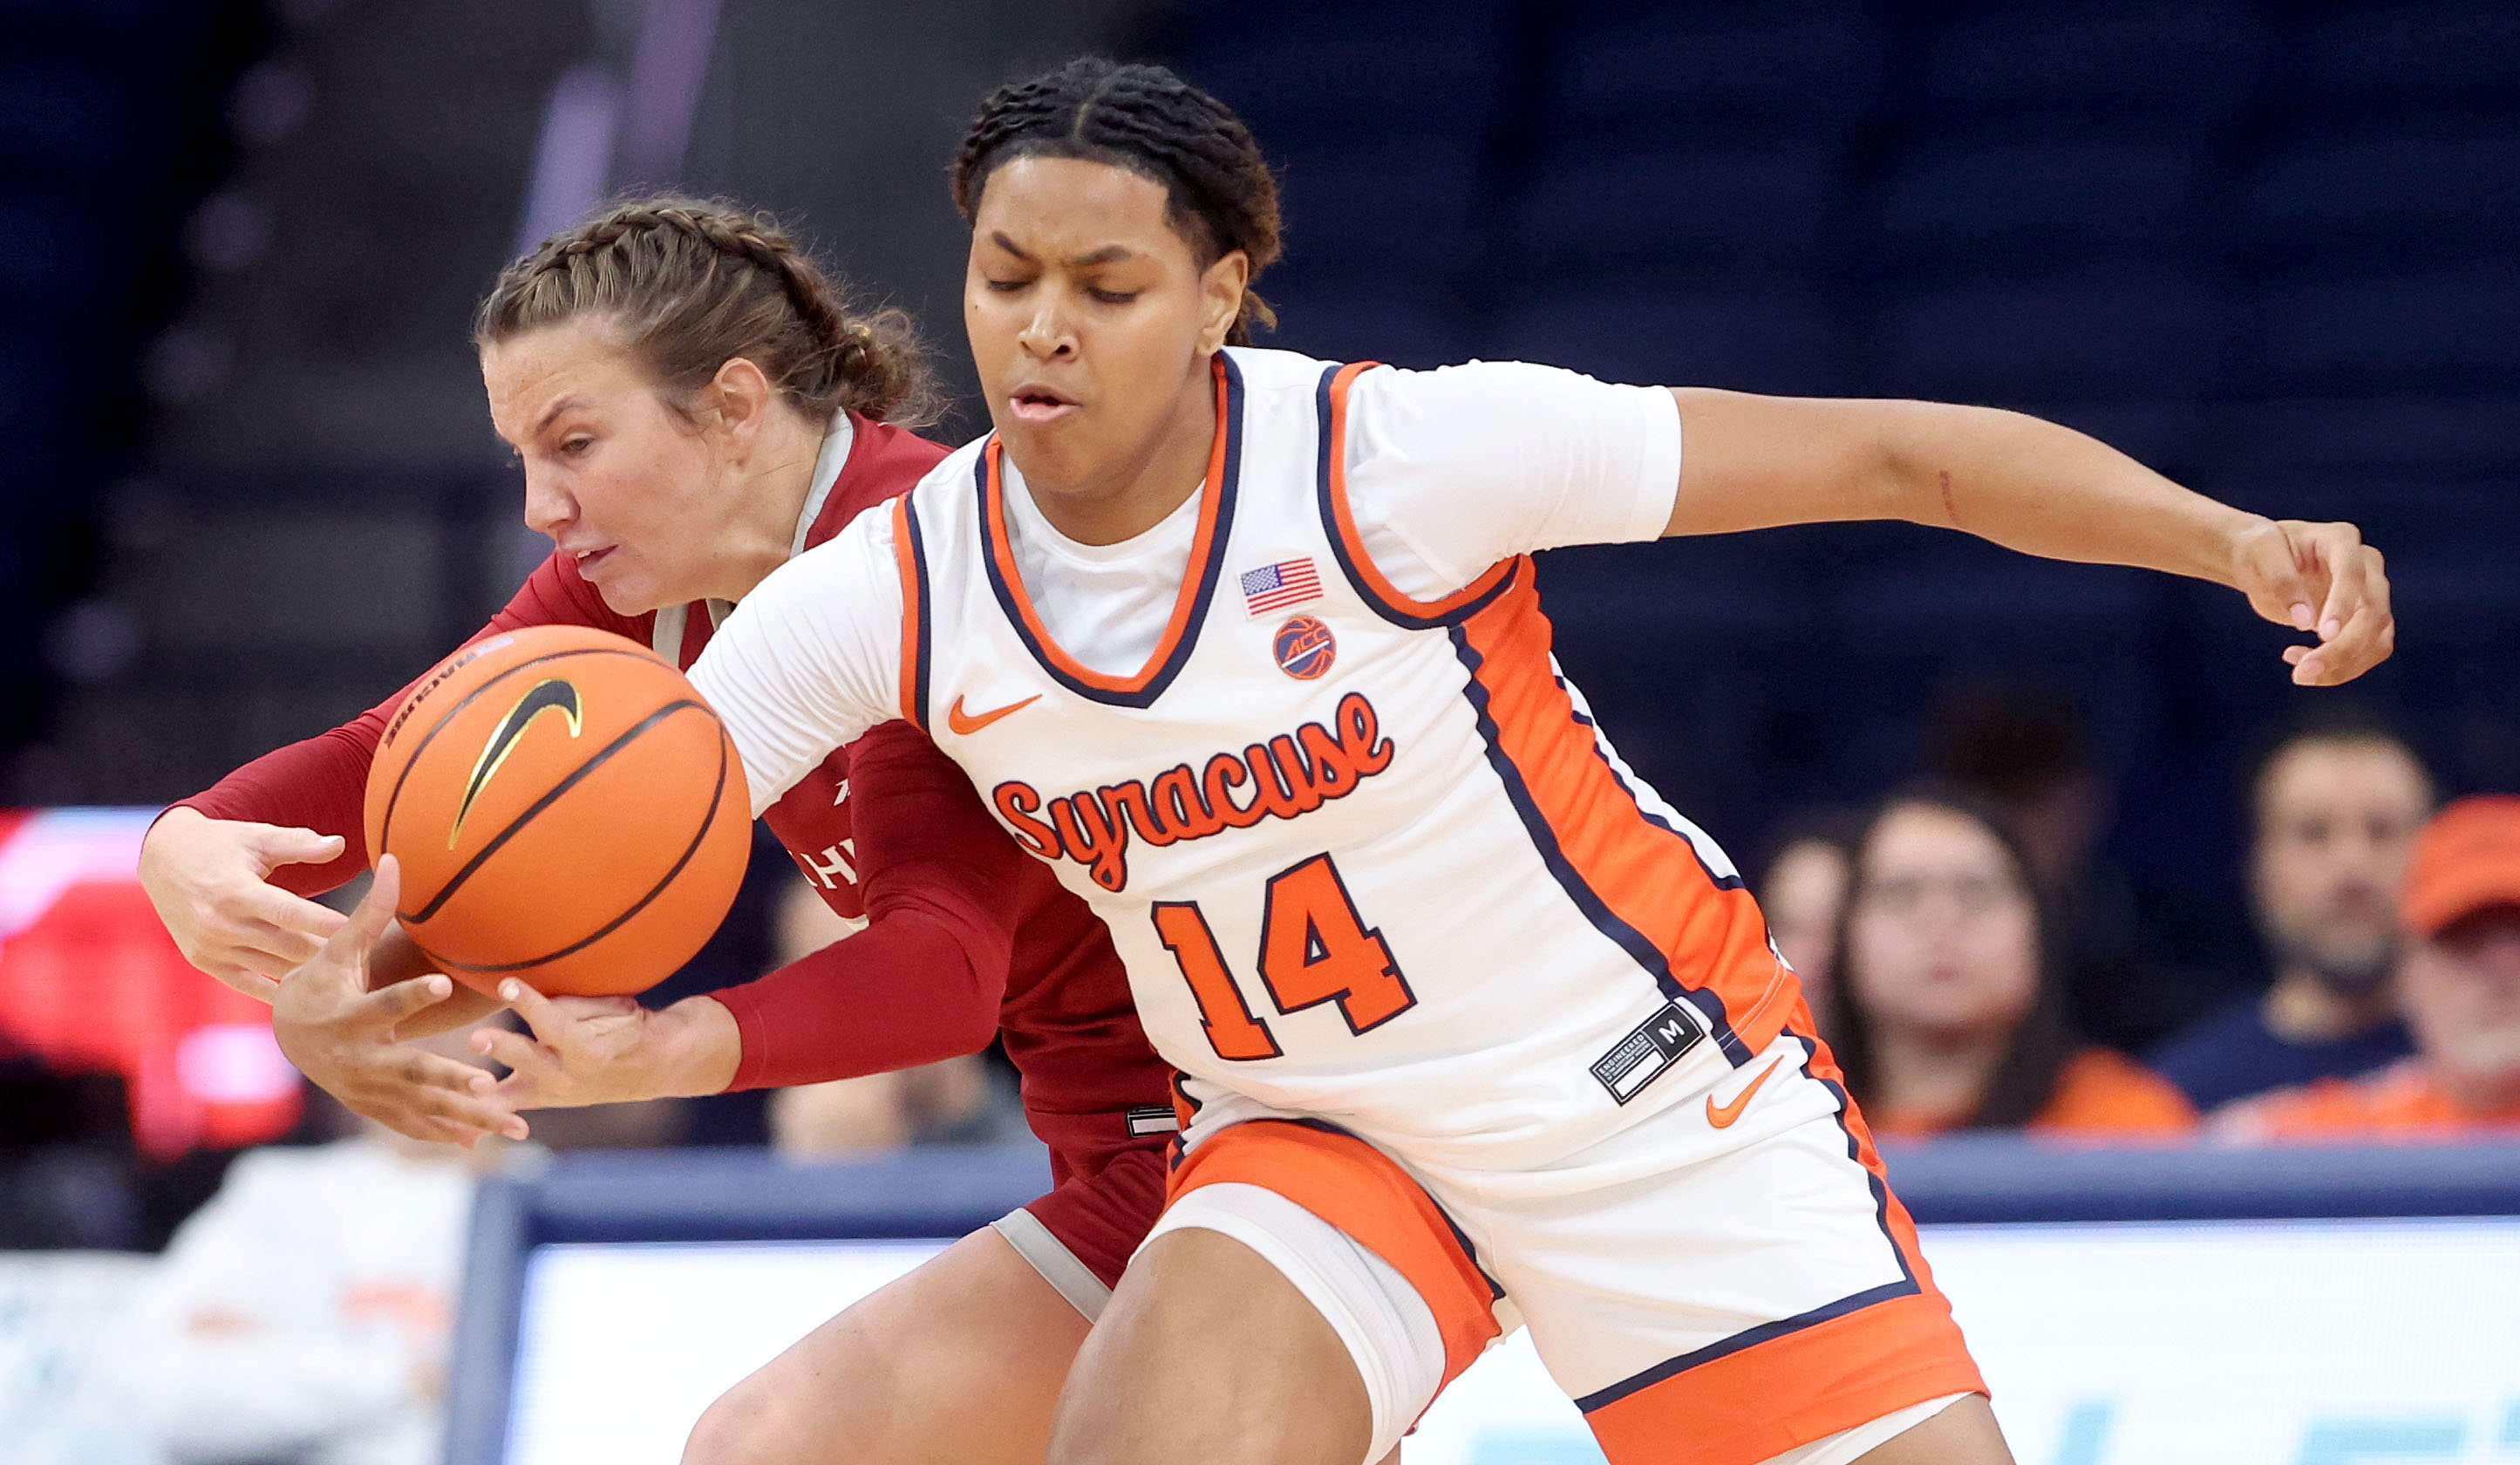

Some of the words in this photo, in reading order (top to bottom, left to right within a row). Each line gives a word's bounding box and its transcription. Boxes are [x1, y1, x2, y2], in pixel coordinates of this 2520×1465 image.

[1284, 625, 1330, 660] ACC
[993, 692, 1394, 893] Syracuse
[1151, 851, 1418, 1061] 14
[1658, 1019, 1686, 1045] M
[1597, 1033, 1645, 1074] ENGINEERED
